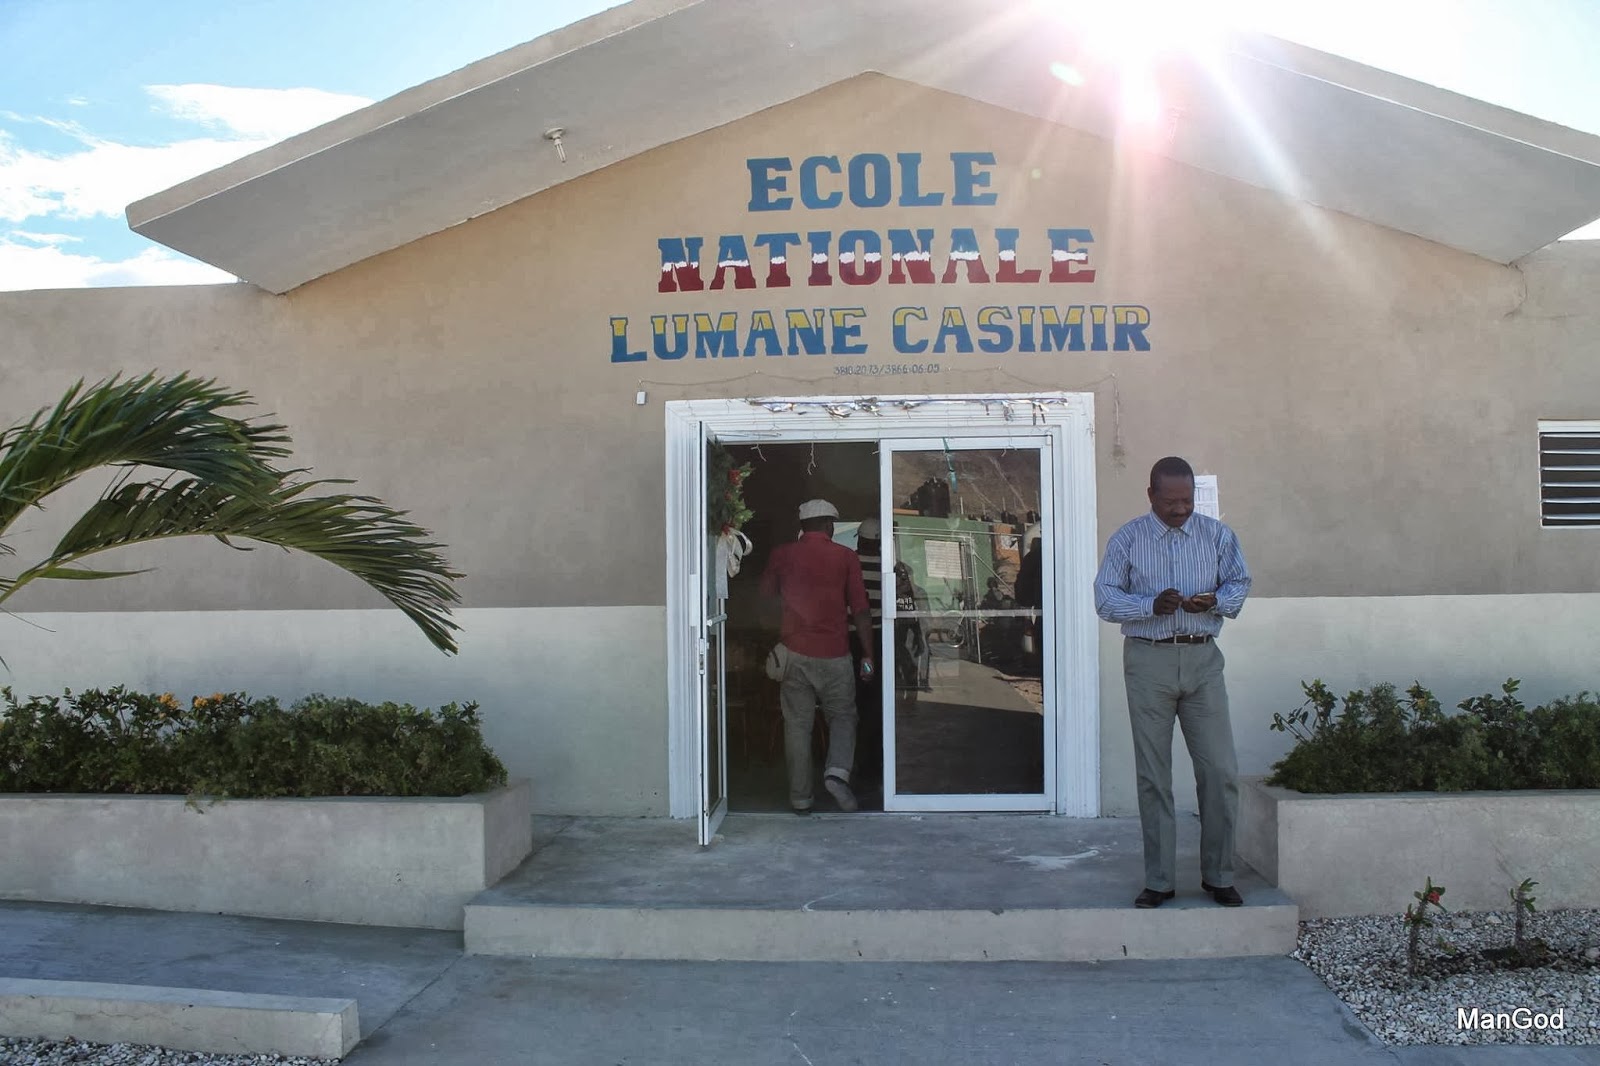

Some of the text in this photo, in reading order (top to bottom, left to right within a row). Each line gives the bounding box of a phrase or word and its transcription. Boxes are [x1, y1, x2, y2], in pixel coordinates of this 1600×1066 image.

[747, 151, 997, 211] ECOLE
[657, 228, 1095, 293] NATIONALE
[610, 305, 1151, 362] LUMANE CASIMIR
